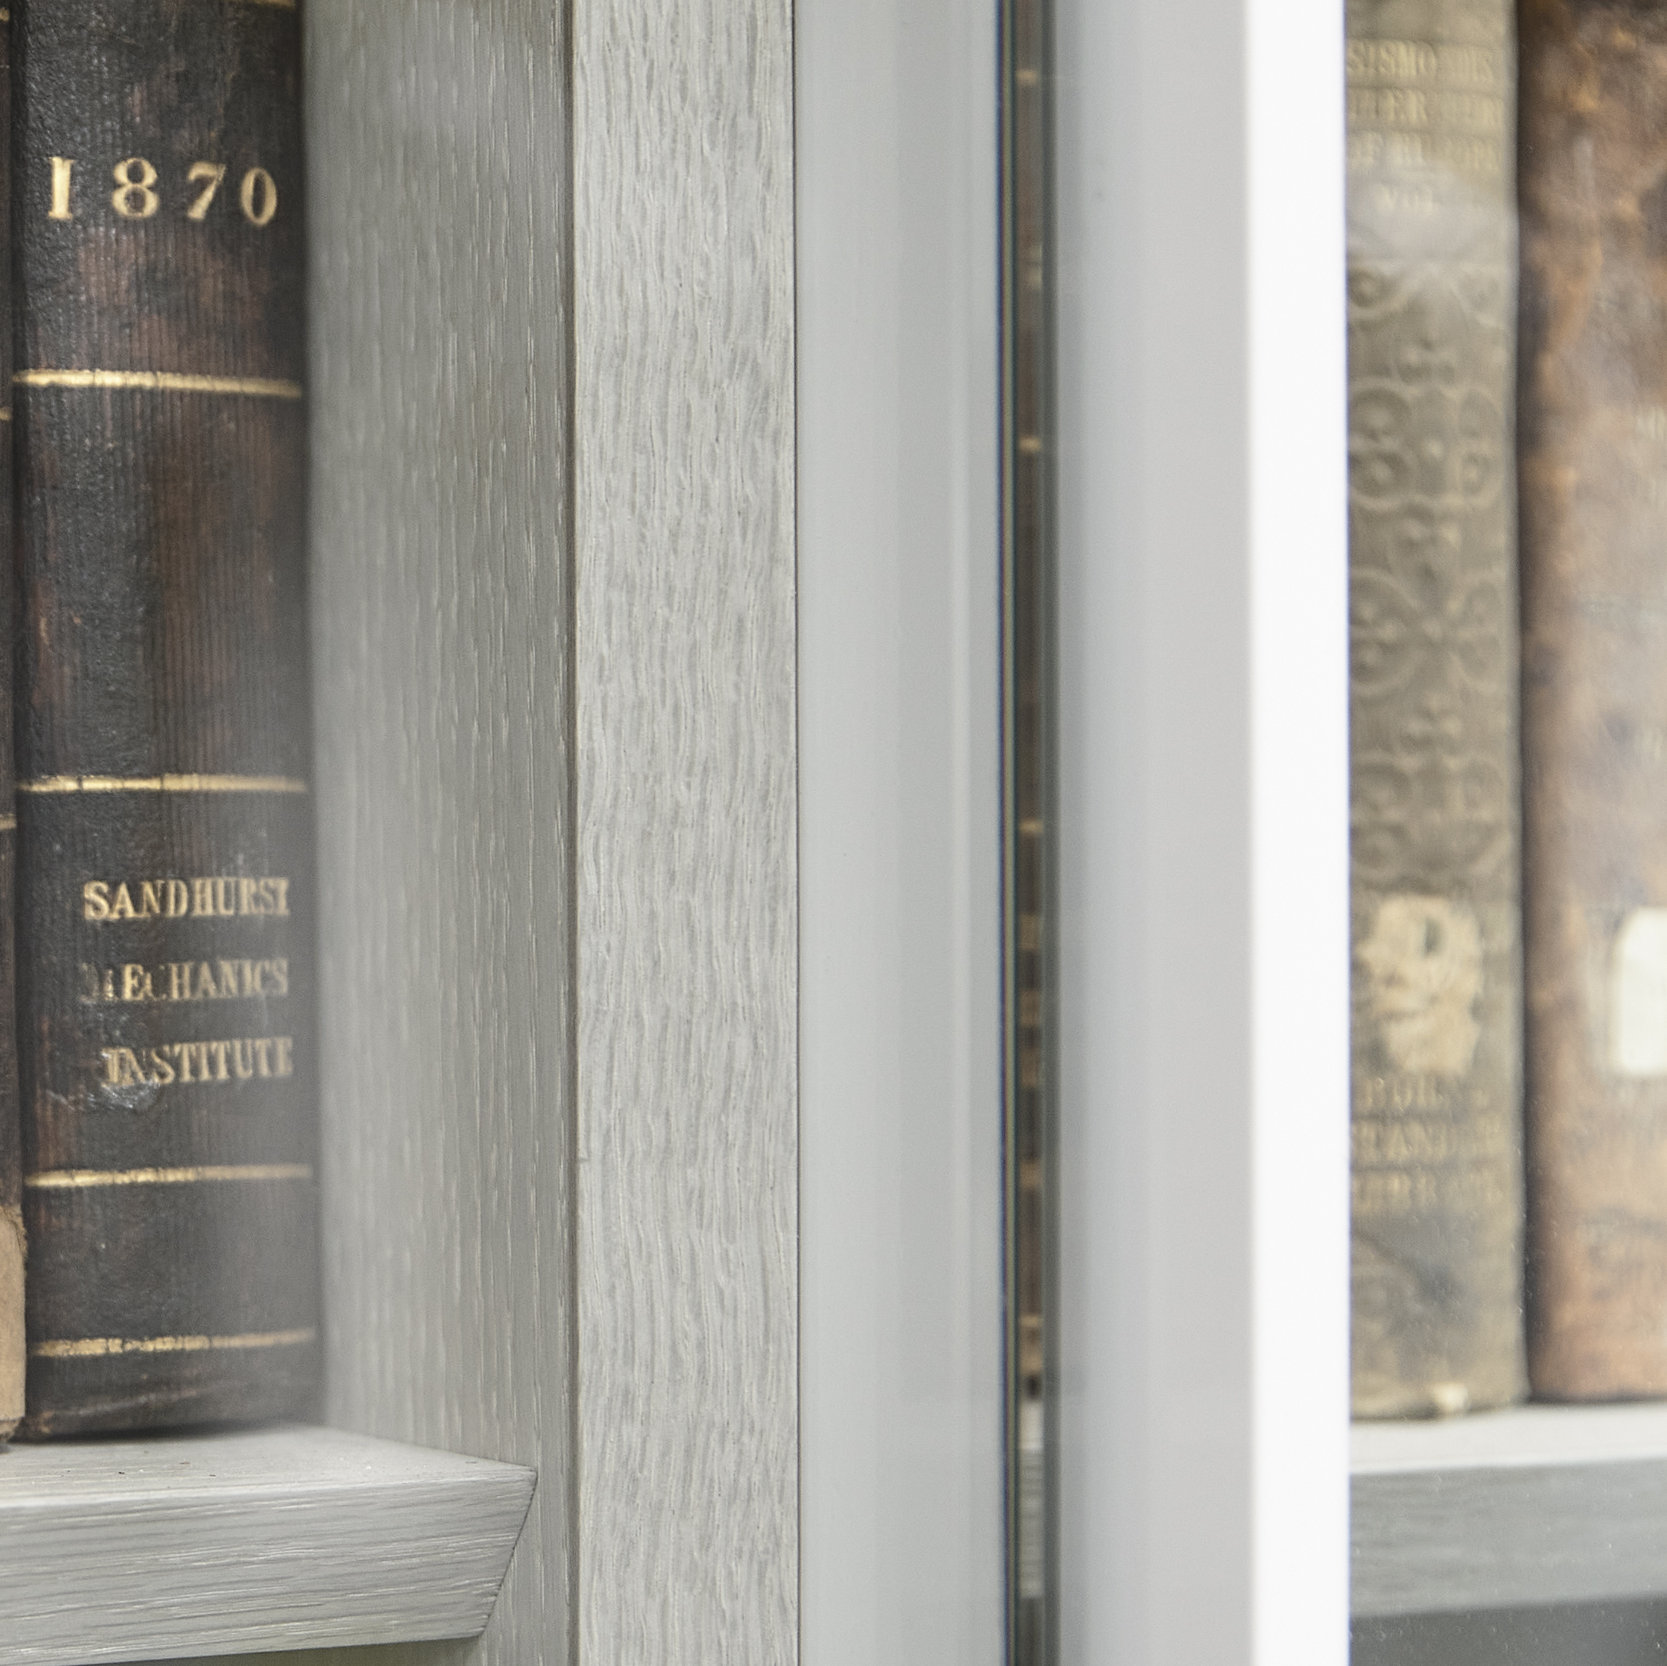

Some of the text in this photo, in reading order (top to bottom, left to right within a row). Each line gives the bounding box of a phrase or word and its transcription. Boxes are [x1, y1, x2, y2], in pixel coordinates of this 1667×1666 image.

[48, 155, 278, 226] 1870
[83, 877, 290, 921] SANDHURST
[100, 1036, 293, 1087] INSTITUTE
